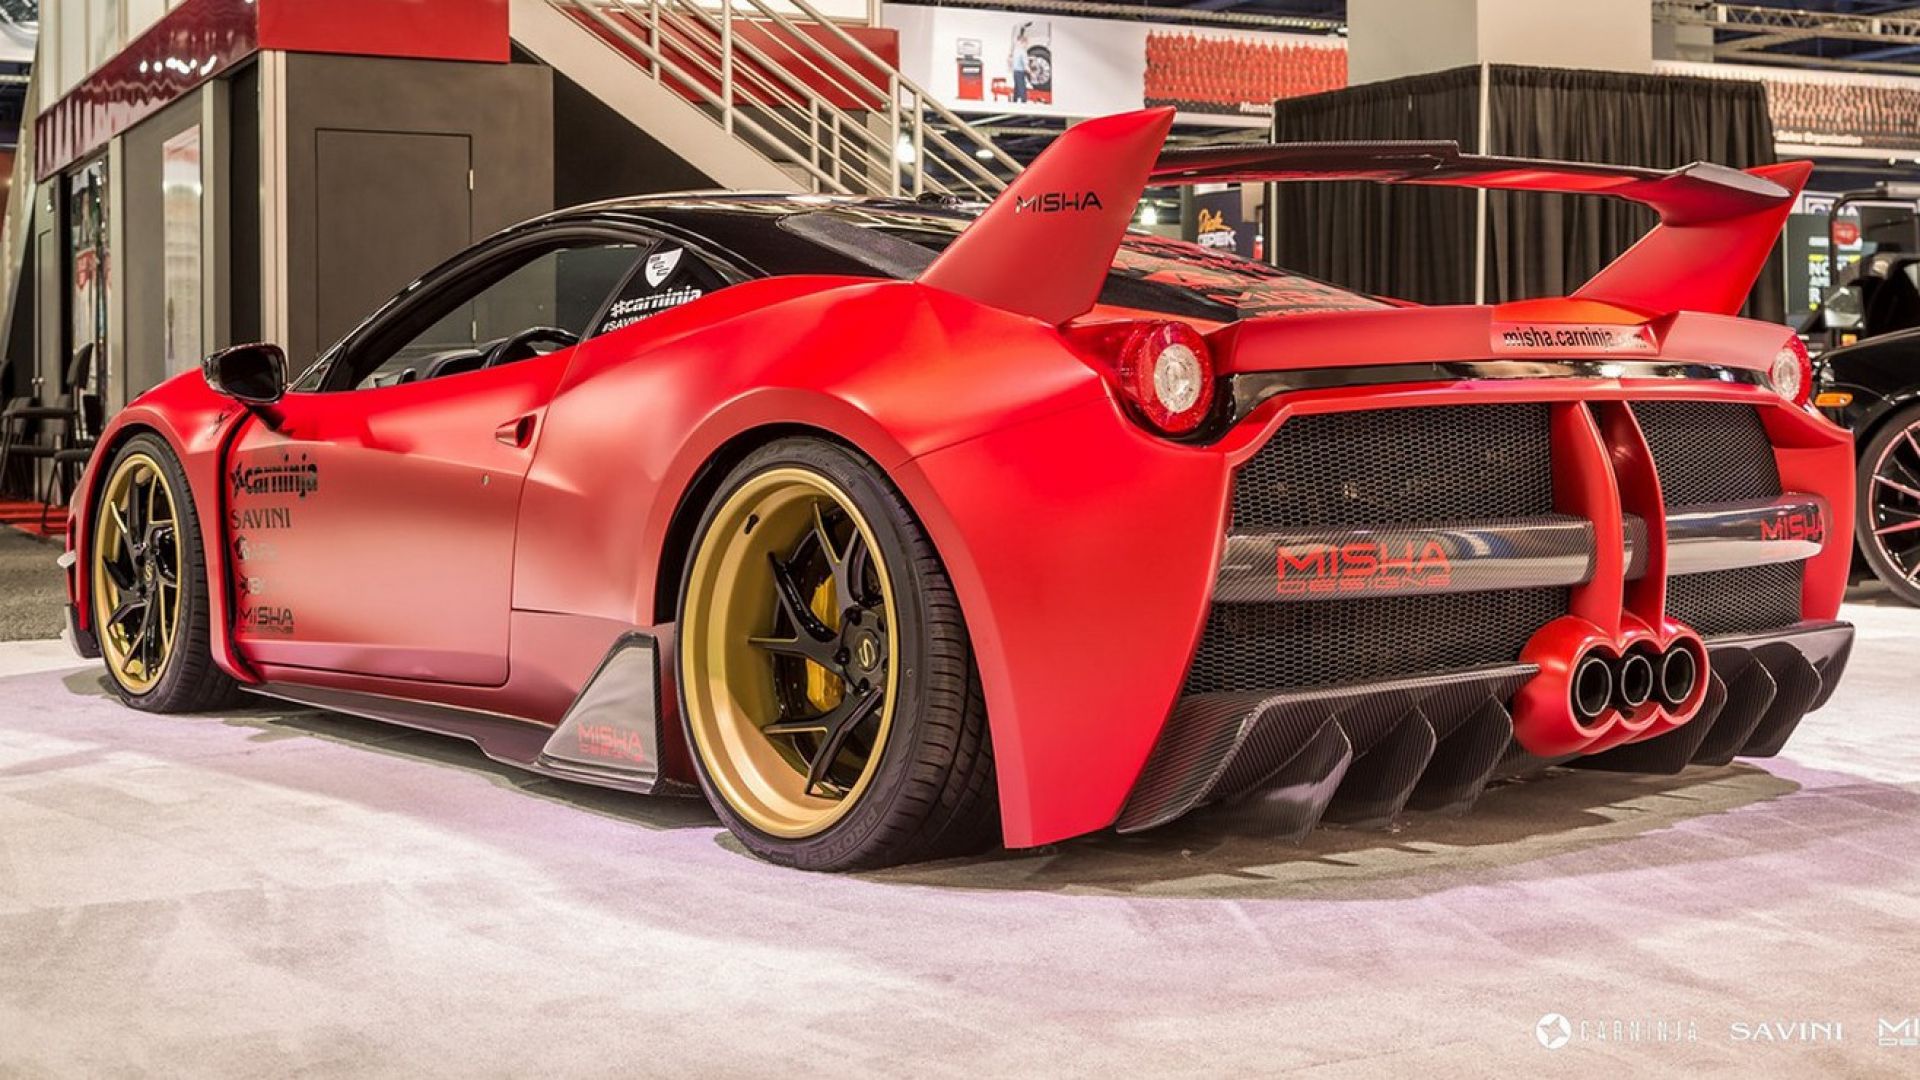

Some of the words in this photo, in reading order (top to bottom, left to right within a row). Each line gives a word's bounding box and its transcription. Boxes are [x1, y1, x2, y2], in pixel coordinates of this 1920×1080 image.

[1016, 192, 1103, 212] MISHA
[231, 508, 290, 529] SAVINI
[1277, 540, 1452, 580] MISHA
[1277, 575, 1451, 593] DESIGNS
[240, 606, 294, 625] MISHA
